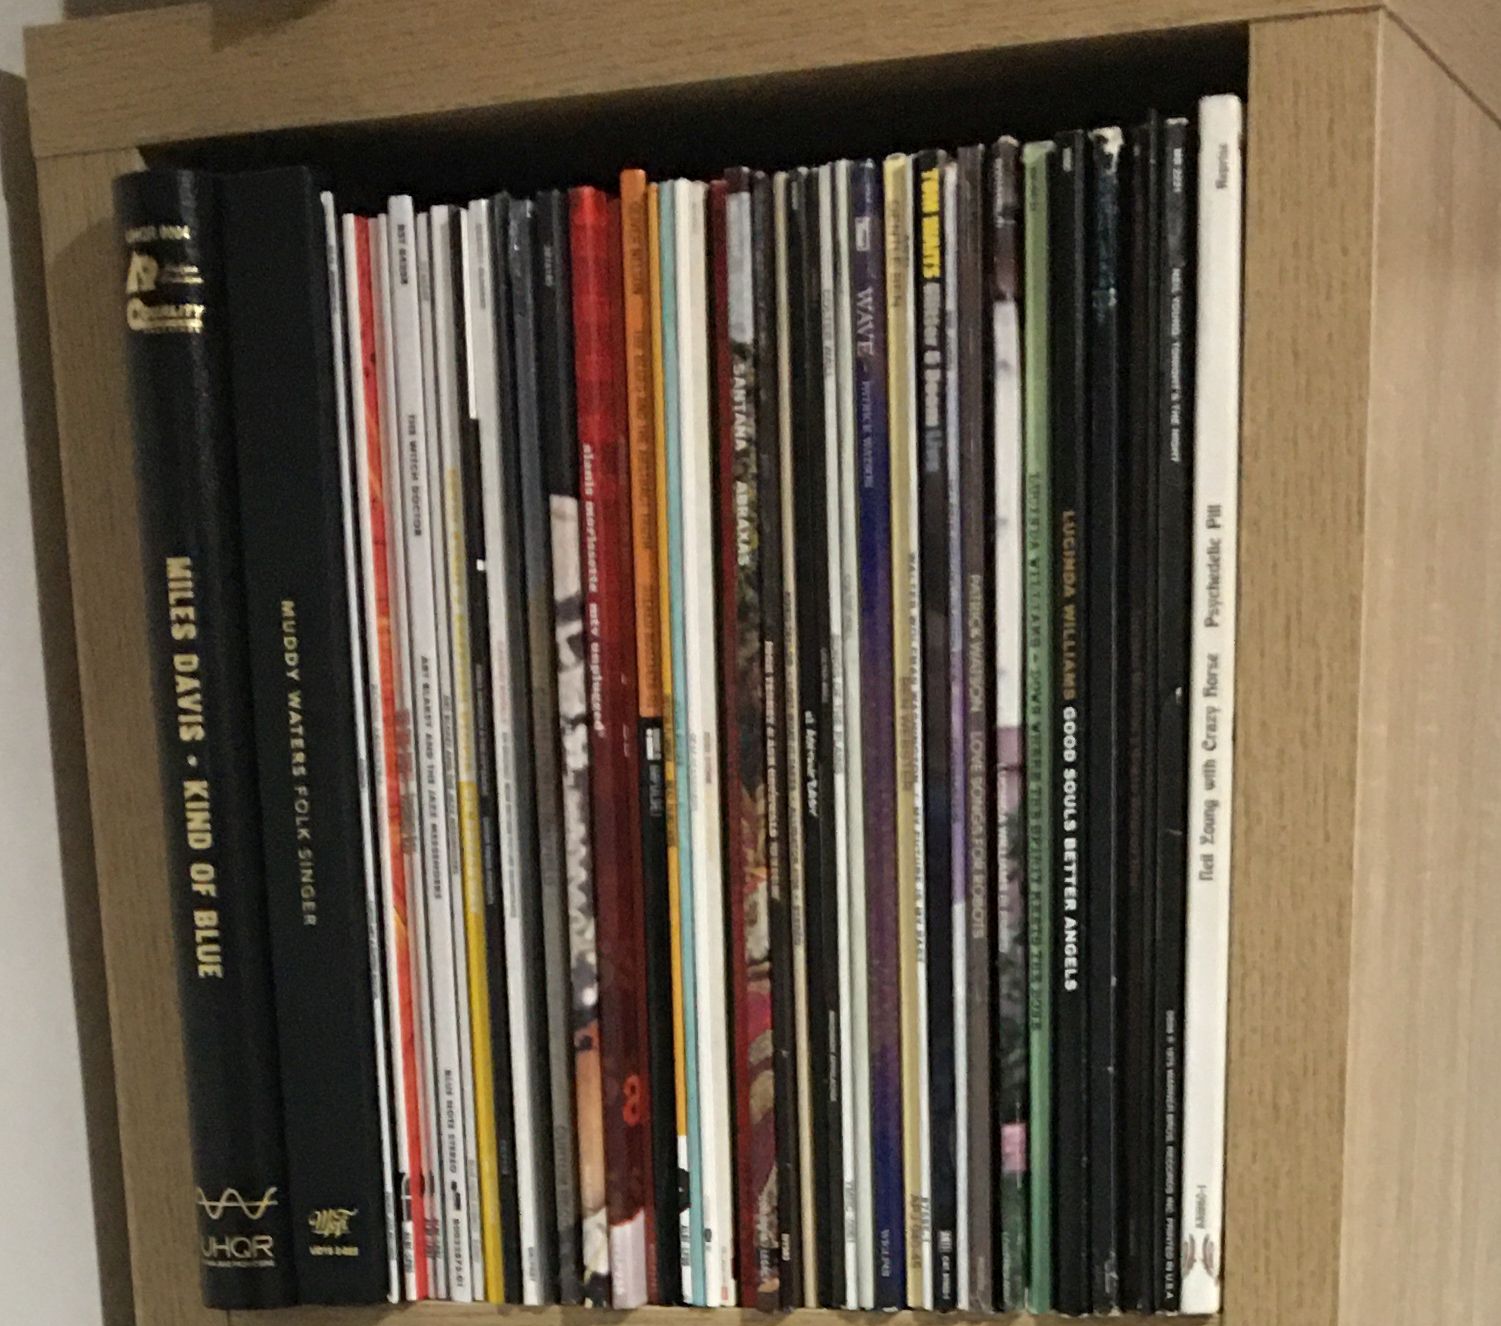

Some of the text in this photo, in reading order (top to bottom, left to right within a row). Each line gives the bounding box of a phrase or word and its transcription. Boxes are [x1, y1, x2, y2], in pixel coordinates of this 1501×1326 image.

[921, 168, 940, 213] TOM
[922, 215, 942, 279] WAITS
[856, 285, 875, 357] WAVE
[1170, 268, 1180, 463] NEIL YOUNG TONIGHT'S THE NIGHT
[409, 441, 420, 481] WITCH
[733, 363, 750, 566] SANTANA ABRAXAS
[411, 486, 422, 537] DOCTOR
[1029, 472, 1041, 552] LUCINDA
[582, 443, 605, 732] alanis morissette mtv unplugged
[1029, 557, 1041, 647] WILLIAMS
[1199, 504, 1222, 881] Neil Young with Crazy Horse Psychedelic Pill
[166, 557, 223, 979] MILES DAVIS KIND OF BLUE
[281, 600, 318, 927] MUDDY WATERS FOLK SINGER
[426, 733, 436, 759] AND
[428, 764, 437, 785] THE
[969, 574, 985, 939] PATRICK WATSON LOVE SONGS FOR ROBOTS
[1062, 511, 1077, 992] LUCINDA WILLIAMS GOOD SOULS BETTER ANGELS
[429, 790, 439, 819] JAZZ
[430, 824, 442, 901] MESSENGERS
[1166, 1069, 1174, 1272] WARNER RECORDS PRINTED IN
[201, 1235, 275, 1259] UHQR
